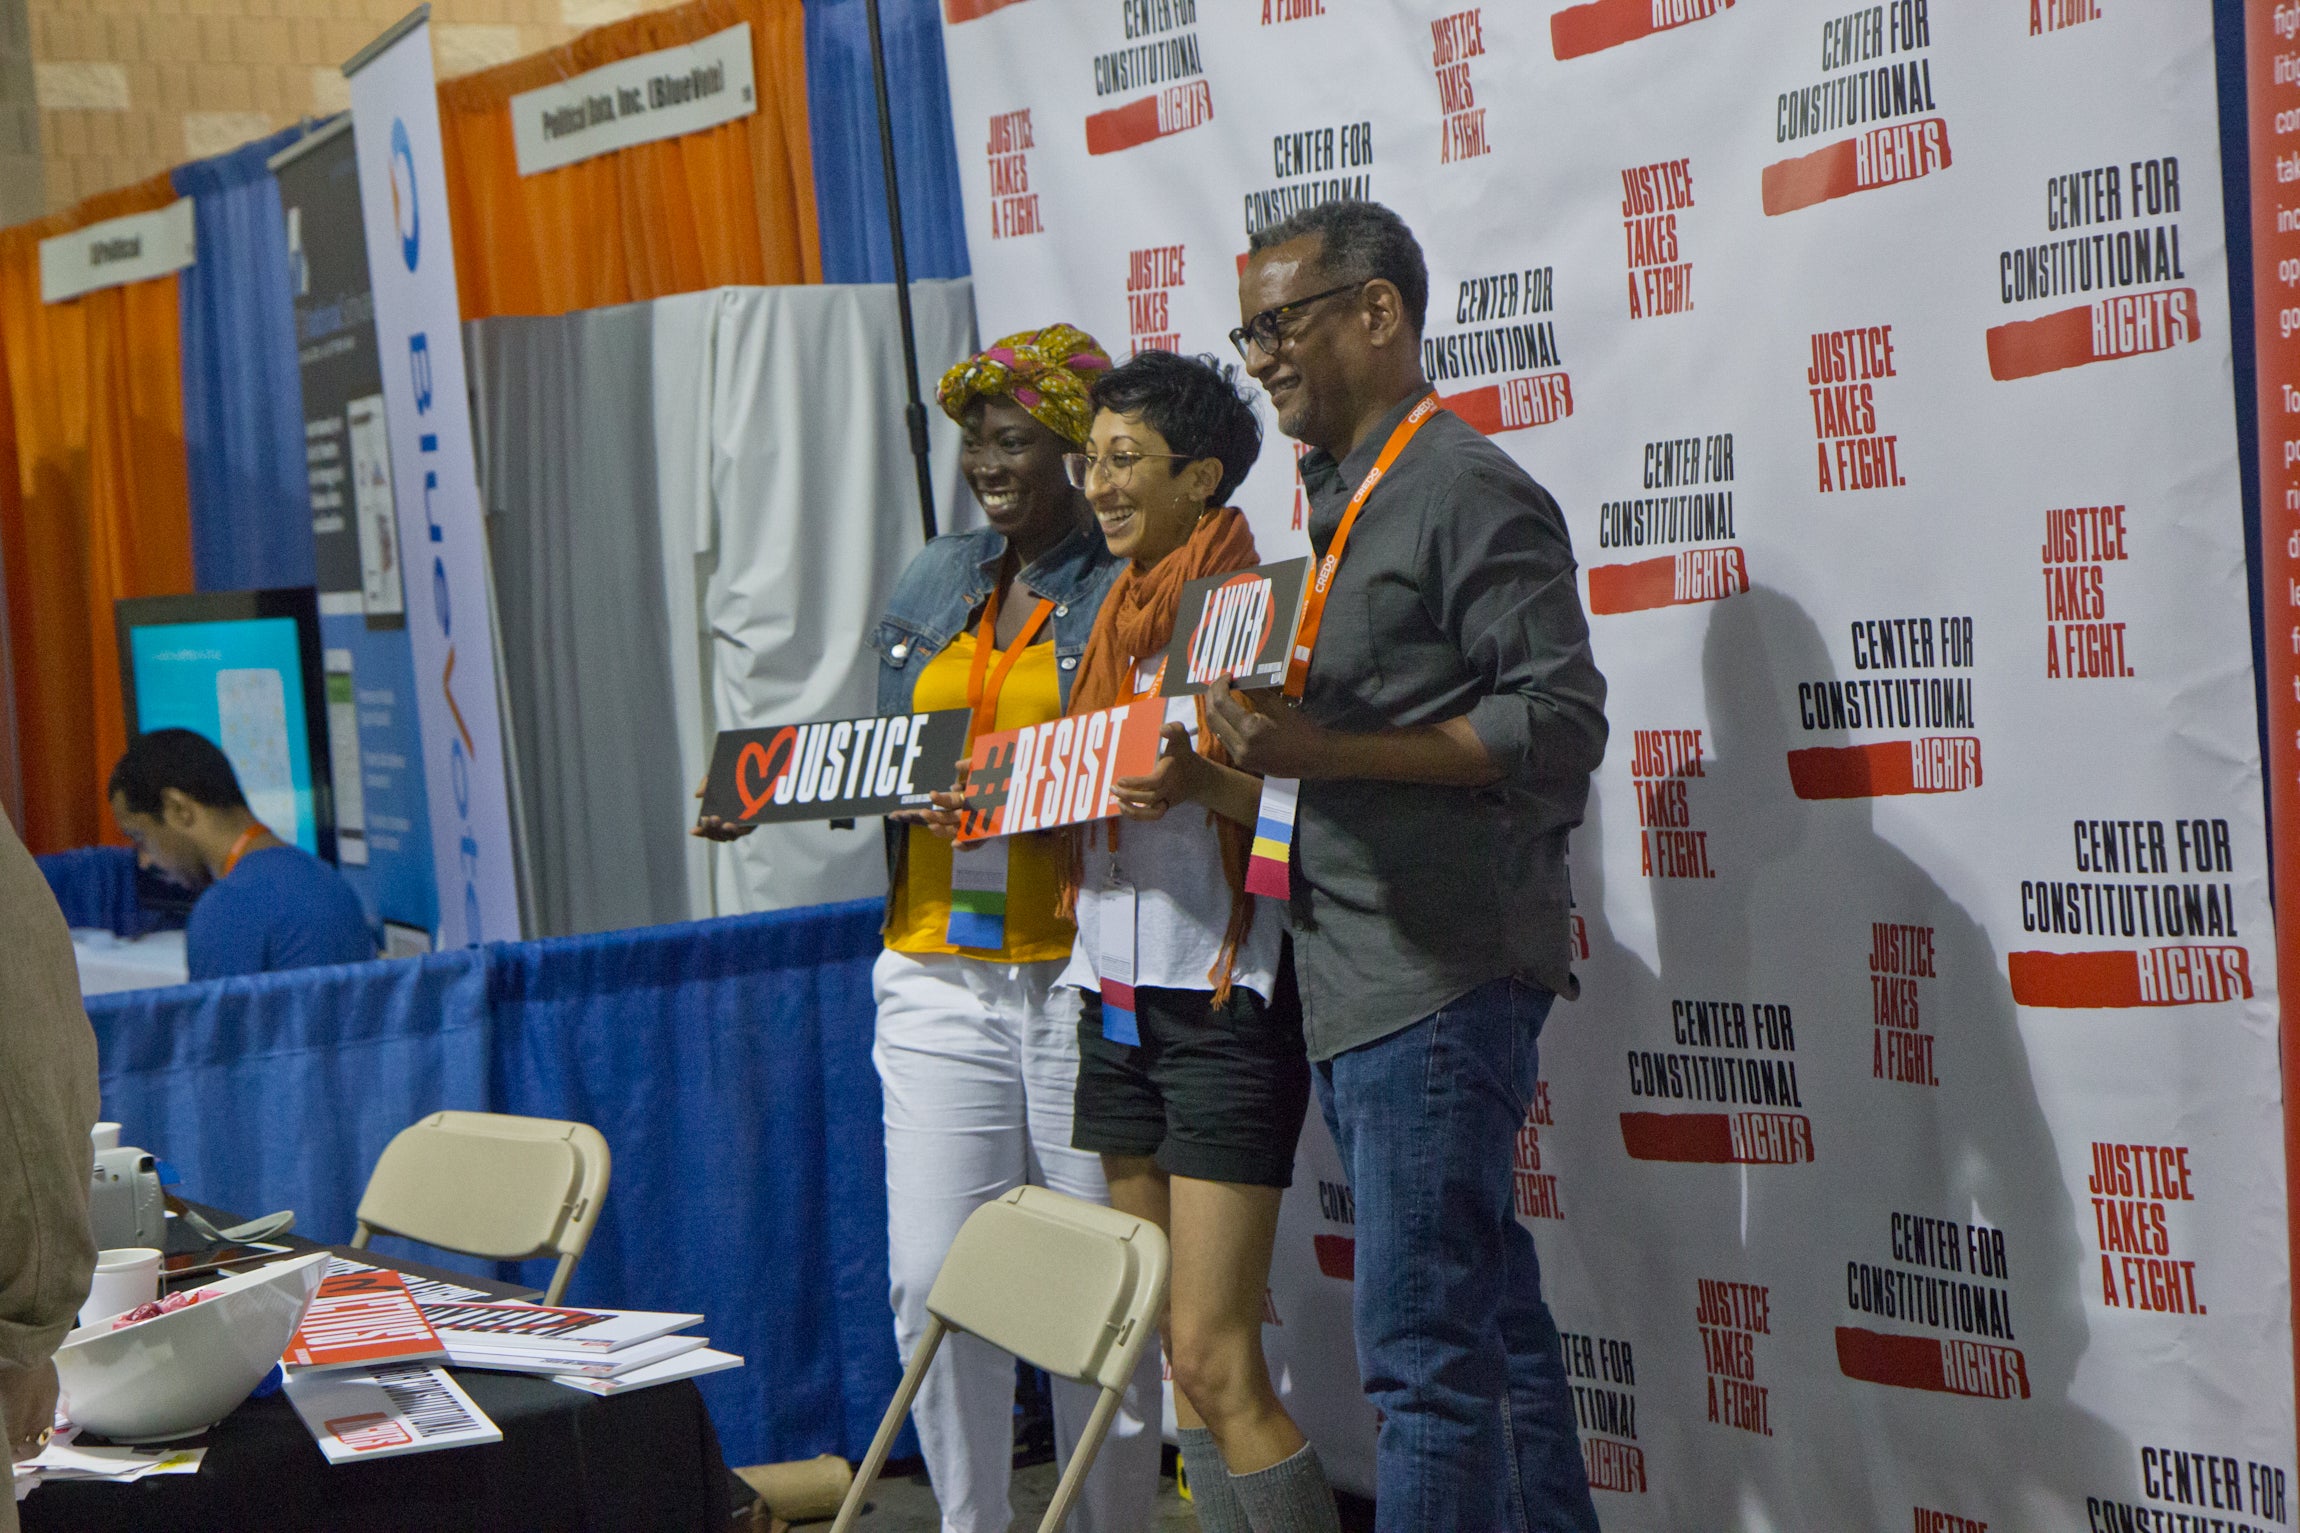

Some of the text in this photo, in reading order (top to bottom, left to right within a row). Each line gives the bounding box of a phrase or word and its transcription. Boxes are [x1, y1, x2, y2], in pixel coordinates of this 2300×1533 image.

[1124, 0, 1169, 39] CENTER
[1431, 8, 1485, 67] JUSTICE
[1822, 0, 1930, 71] CENTER FOR
[1094, 33, 1203, 96] CONSTITUTIONAL
[1435, 62, 1474, 115] TAKES
[1157, 82, 1208, 133] RIGHTS
[1777, 58, 1935, 143] CONSTITUTIONAL
[987, 108, 1035, 156] JUSTICE
[1274, 121, 1372, 178] CENTER FOR
[1442, 108, 1491, 165] A FIGHT.
[1856, 120, 1940, 187] RIGHTS
[988, 153, 1029, 198] TAKES
[1621, 158, 1694, 218] JUSTICE
[2048, 157, 2181, 231] CENTER FOR
[992, 194, 1044, 239] A FIGHT.
[1624, 214, 1678, 269] TAKES
[1127, 245, 1185, 291] JUSTICE
[1628, 263, 1694, 320] A FIGHT.
[2000, 224, 2185, 304] CONSTITUTIONAL
[1128, 291, 1168, 335] TAKES
[1457, 266, 1553, 324] CENTER FOR
[1421, 321, 1561, 382] ONSTITUTIONAL
[2092, 291, 2188, 357] RIGHTS
[1808, 325, 1896, 385] JUSTICE
[1408, 397, 1434, 424] CREDO
[1499, 374, 1567, 428] RIGHTS
[1810, 383, 1875, 438] TAKES
[1353, 466, 1380, 503] CREDO
[1644, 433, 1734, 489] CENTER FOR
[1818, 435, 1906, 492] A FIGHT.
[1600, 491, 1735, 548] CONSTITUTIONAL
[2042, 505, 2128, 564] JUSTICE
[1315, 554, 1336, 593] CREDO
[1674, 548, 1740, 600] RIGHTS
[2042, 566, 2105, 621] TAKES
[1187, 578, 1272, 684] LAWYER
[1850, 616, 1974, 671] CENTER FOR
[2047, 623, 2135, 679] A FIGHT.
[1799, 678, 1974, 730] CONSTITUTIONAL
[774, 714, 929, 805] JUSTICE
[1631, 730, 1705, 778] JUSTICE
[1913, 738, 1976, 789] RIGHTS
[1633, 781, 1690, 827] TAKES
[1641, 830, 1716, 878] A FIGHT.
[2074, 819, 2233, 873] CENTER FOR
[2020, 880, 2238, 937] CONSTITUTIONAL
[1869, 922, 1936, 978] JUSTICE
[2136, 947, 2243, 1002] RIGHTS
[1672, 999, 1795, 1052] CENTER FOR
[1870, 976, 1919, 1030] TAKES
[1627, 1051, 1802, 1107] CONSTITUTIONAL
[1873, 1031, 1939, 1087] A FIGHT.
[1514, 1126, 1541, 1170] KES
[1730, 1112, 1806, 1163] RIGHTS
[2089, 1142, 2195, 1201] JUSTICE
[1891, 1212, 2009, 1281] CENTER FOR
[2091, 1198, 2170, 1257] TAKES
[1696, 1279, 1771, 1335] JUSTICE
[1847, 1262, 2015, 1340] CONSTITUTIONAL
[2102, 1255, 2207, 1315] A FIGHT.
[1561, 1332, 1634, 1386] TER FOR
[1698, 1326, 1754, 1381] TAKES
[1940, 1340, 2020, 1399] RIGHTS
[1708, 1375, 1773, 1437] A FIGHT.
[2141, 1446, 2243, 1511] CENTER
[2248, 1461, 2288, 1525] FOR
